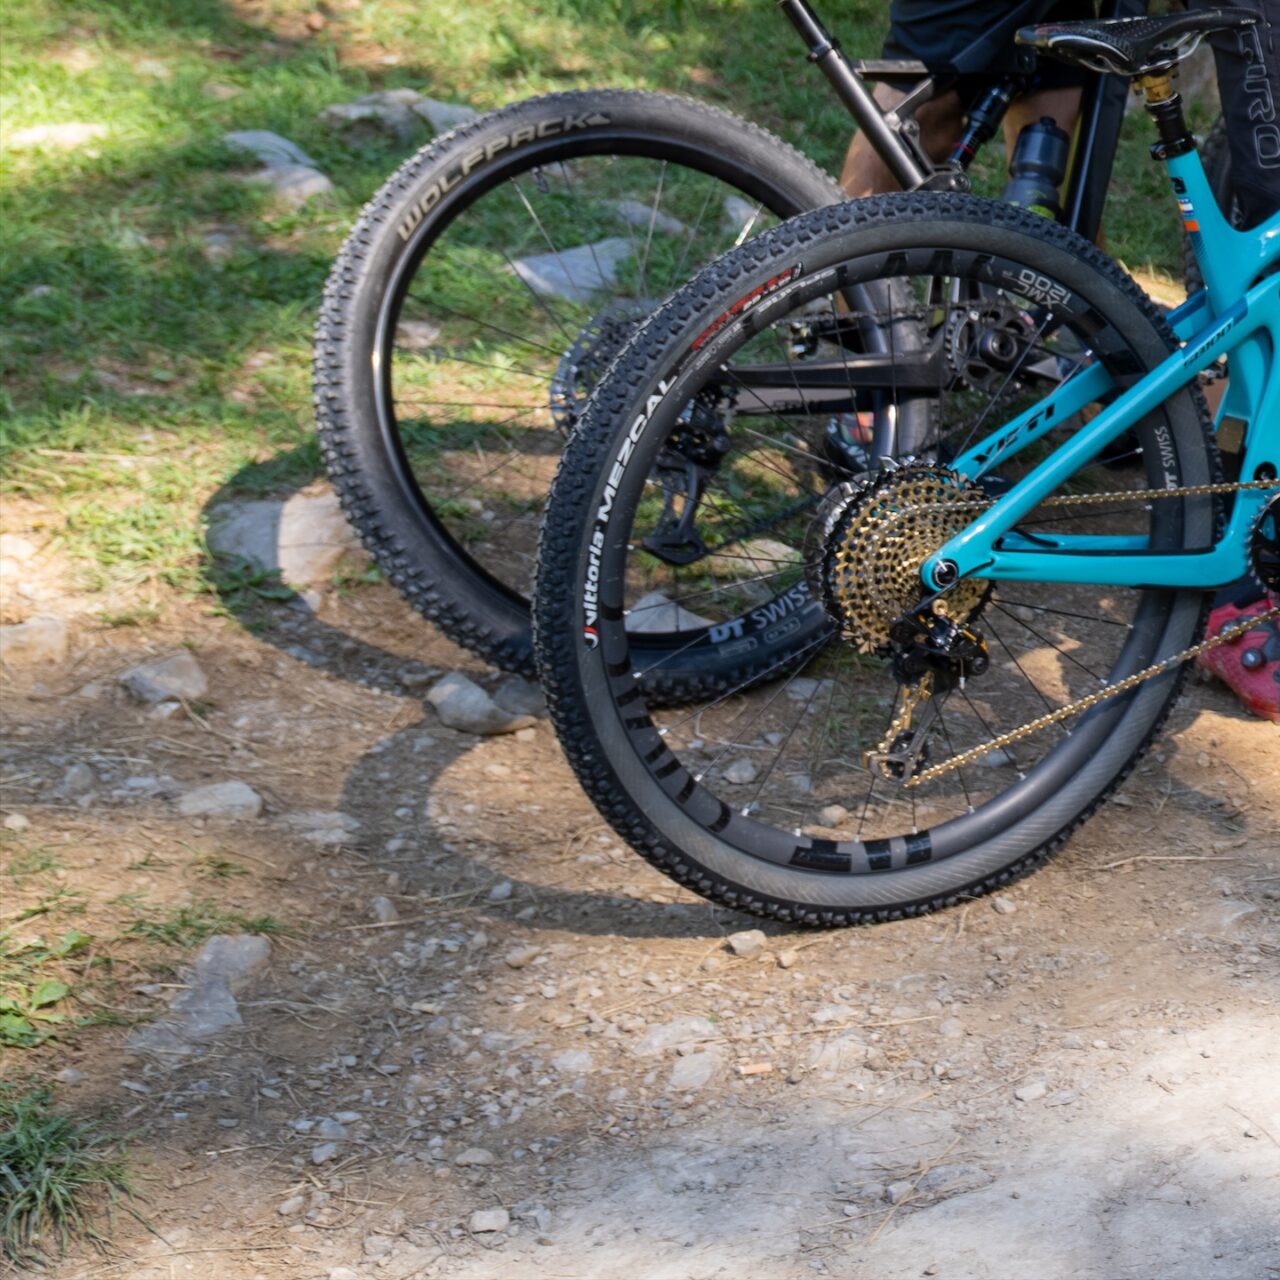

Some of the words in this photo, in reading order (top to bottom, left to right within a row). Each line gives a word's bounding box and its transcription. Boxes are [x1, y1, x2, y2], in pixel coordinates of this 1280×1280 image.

[397, 112, 590, 242] WOLFPACK
[1018, 269, 1073, 306] 1200
[972, 403, 1056, 467] YETI
[1154, 425, 1176, 468] SWISS
[582, 529, 605, 627] vittoria
[597, 374, 678, 523] MEZCAL
[708, 617, 746, 643] DT
